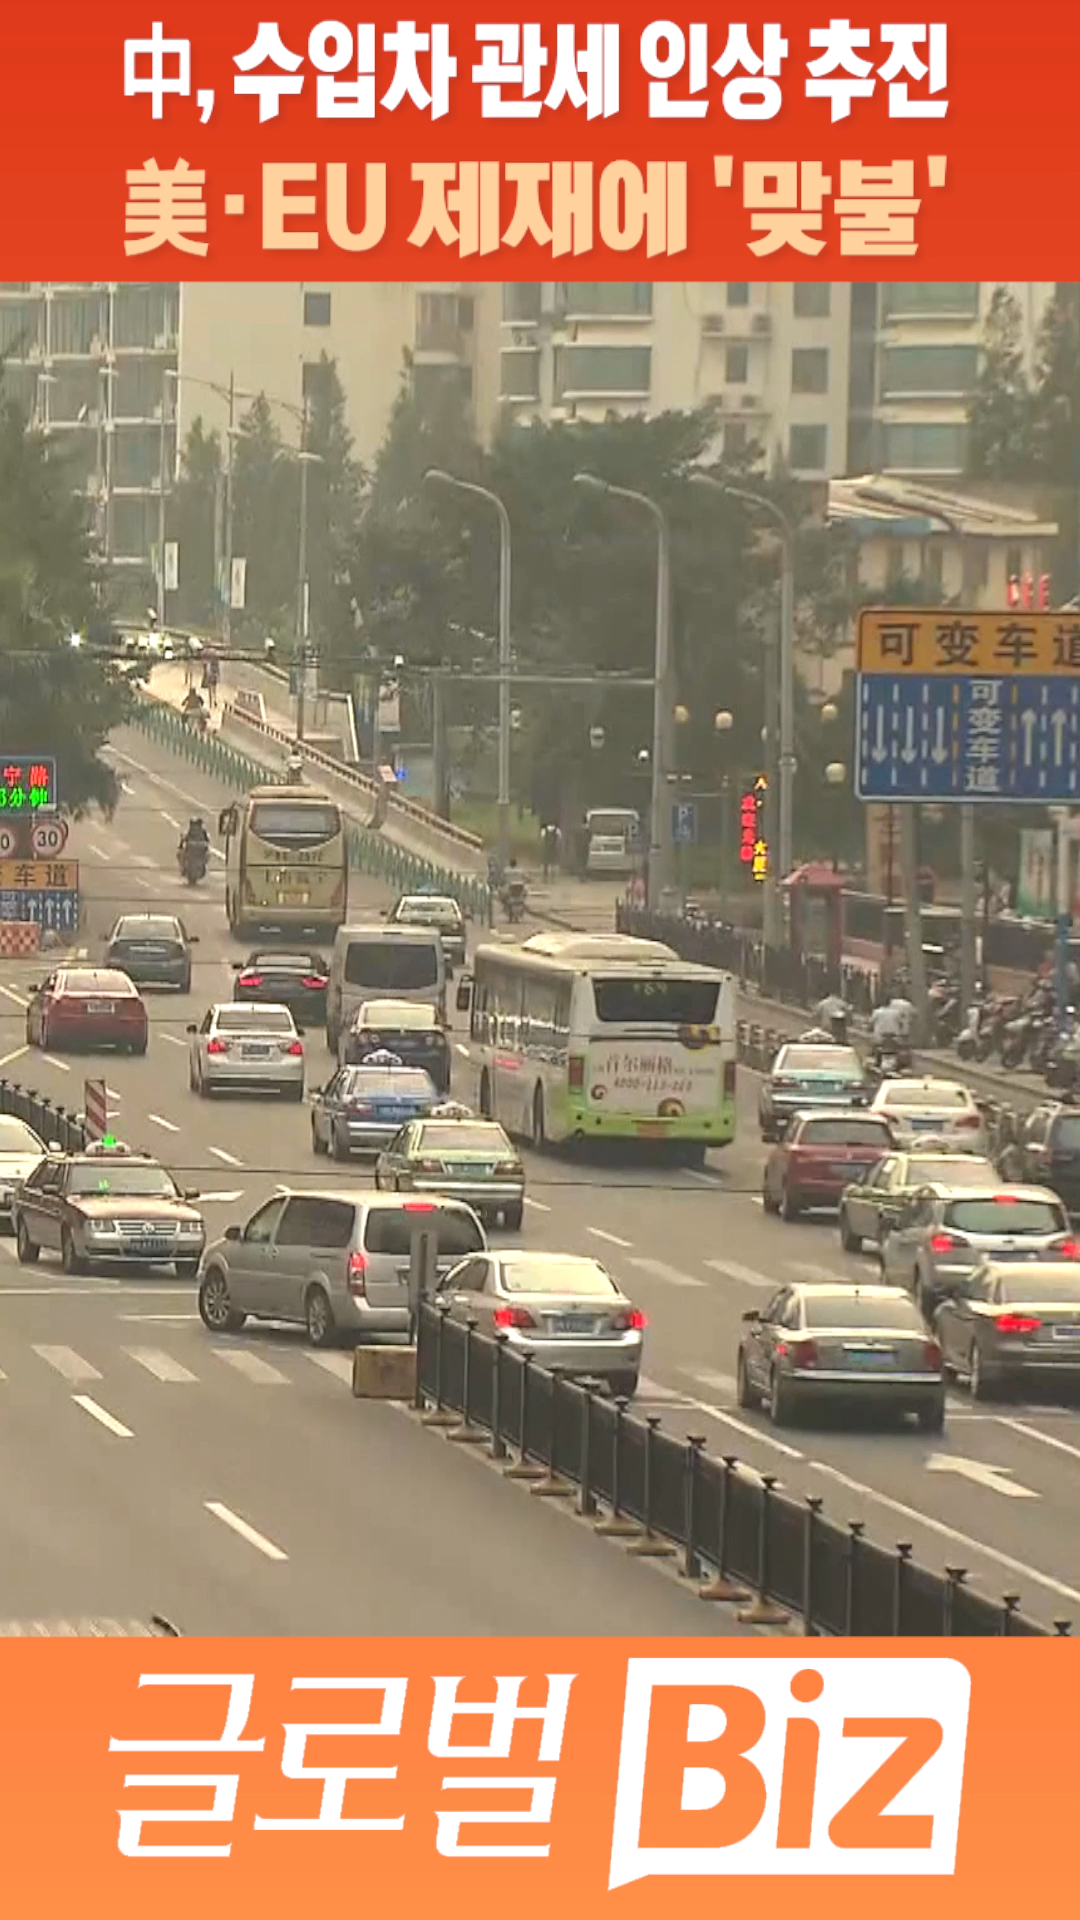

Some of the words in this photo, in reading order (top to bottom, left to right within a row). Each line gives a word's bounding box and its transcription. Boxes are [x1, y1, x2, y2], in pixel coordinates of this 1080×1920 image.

[877, 620, 1080, 667] 可变车道
[964, 680, 1003, 792] 可变车道
[38, 831, 58, 847] 30
[0, 865, 68, 887] 车道
